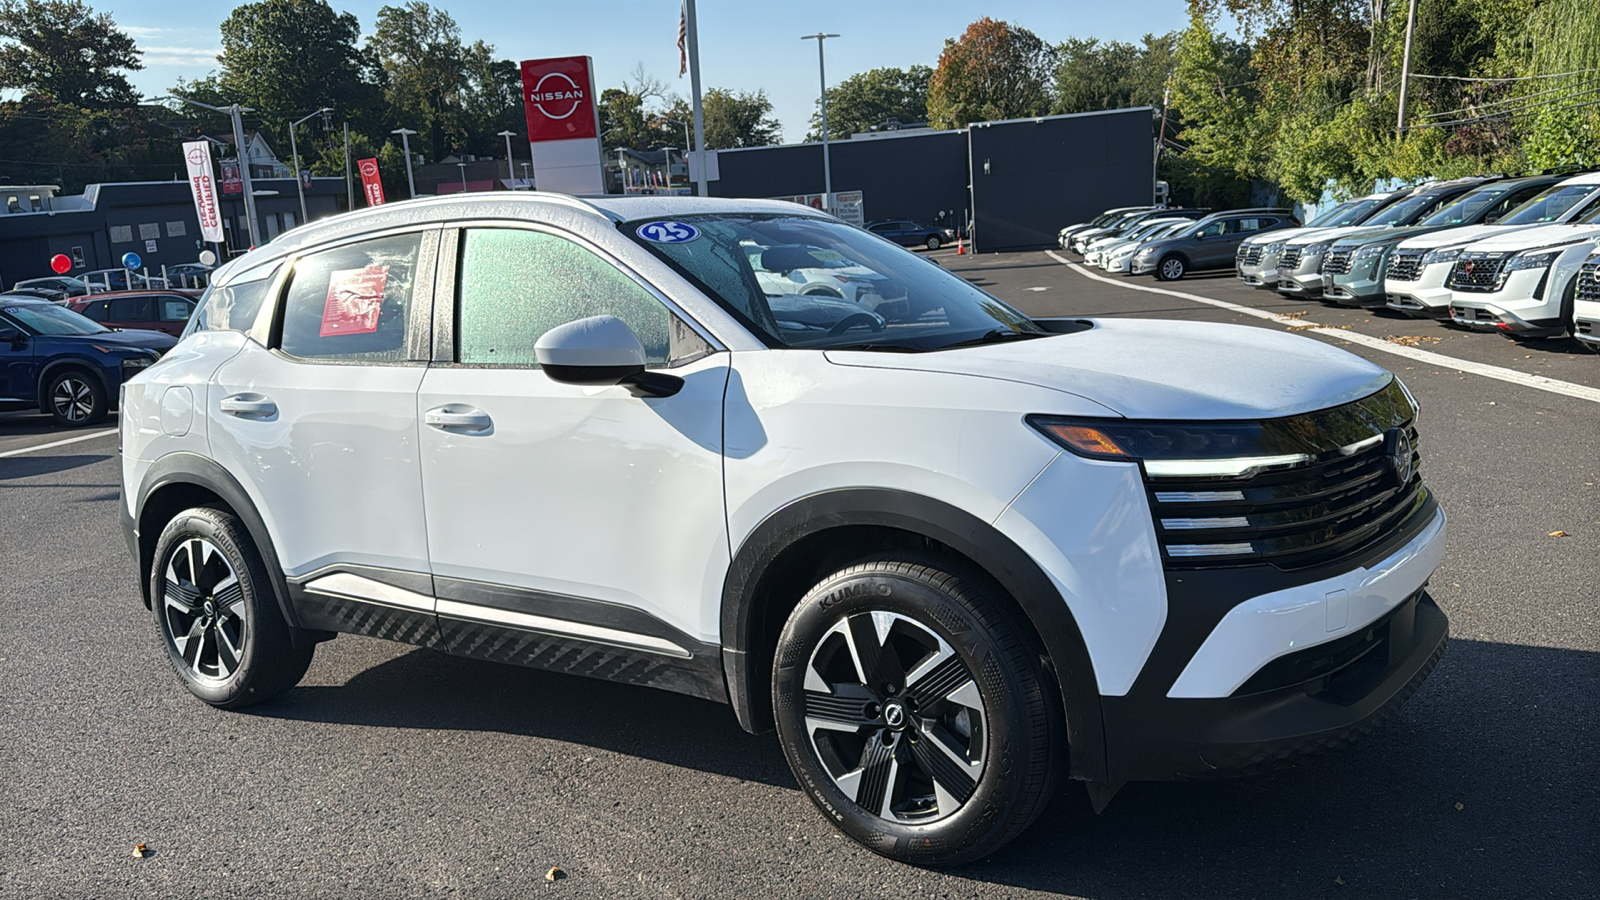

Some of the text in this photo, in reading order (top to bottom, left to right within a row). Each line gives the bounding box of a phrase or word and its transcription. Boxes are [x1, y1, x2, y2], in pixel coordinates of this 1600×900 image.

[530, 90, 584, 102] NISSAN
[647, 221, 690, 242] 25
[819, 583, 893, 612] KUMHO
